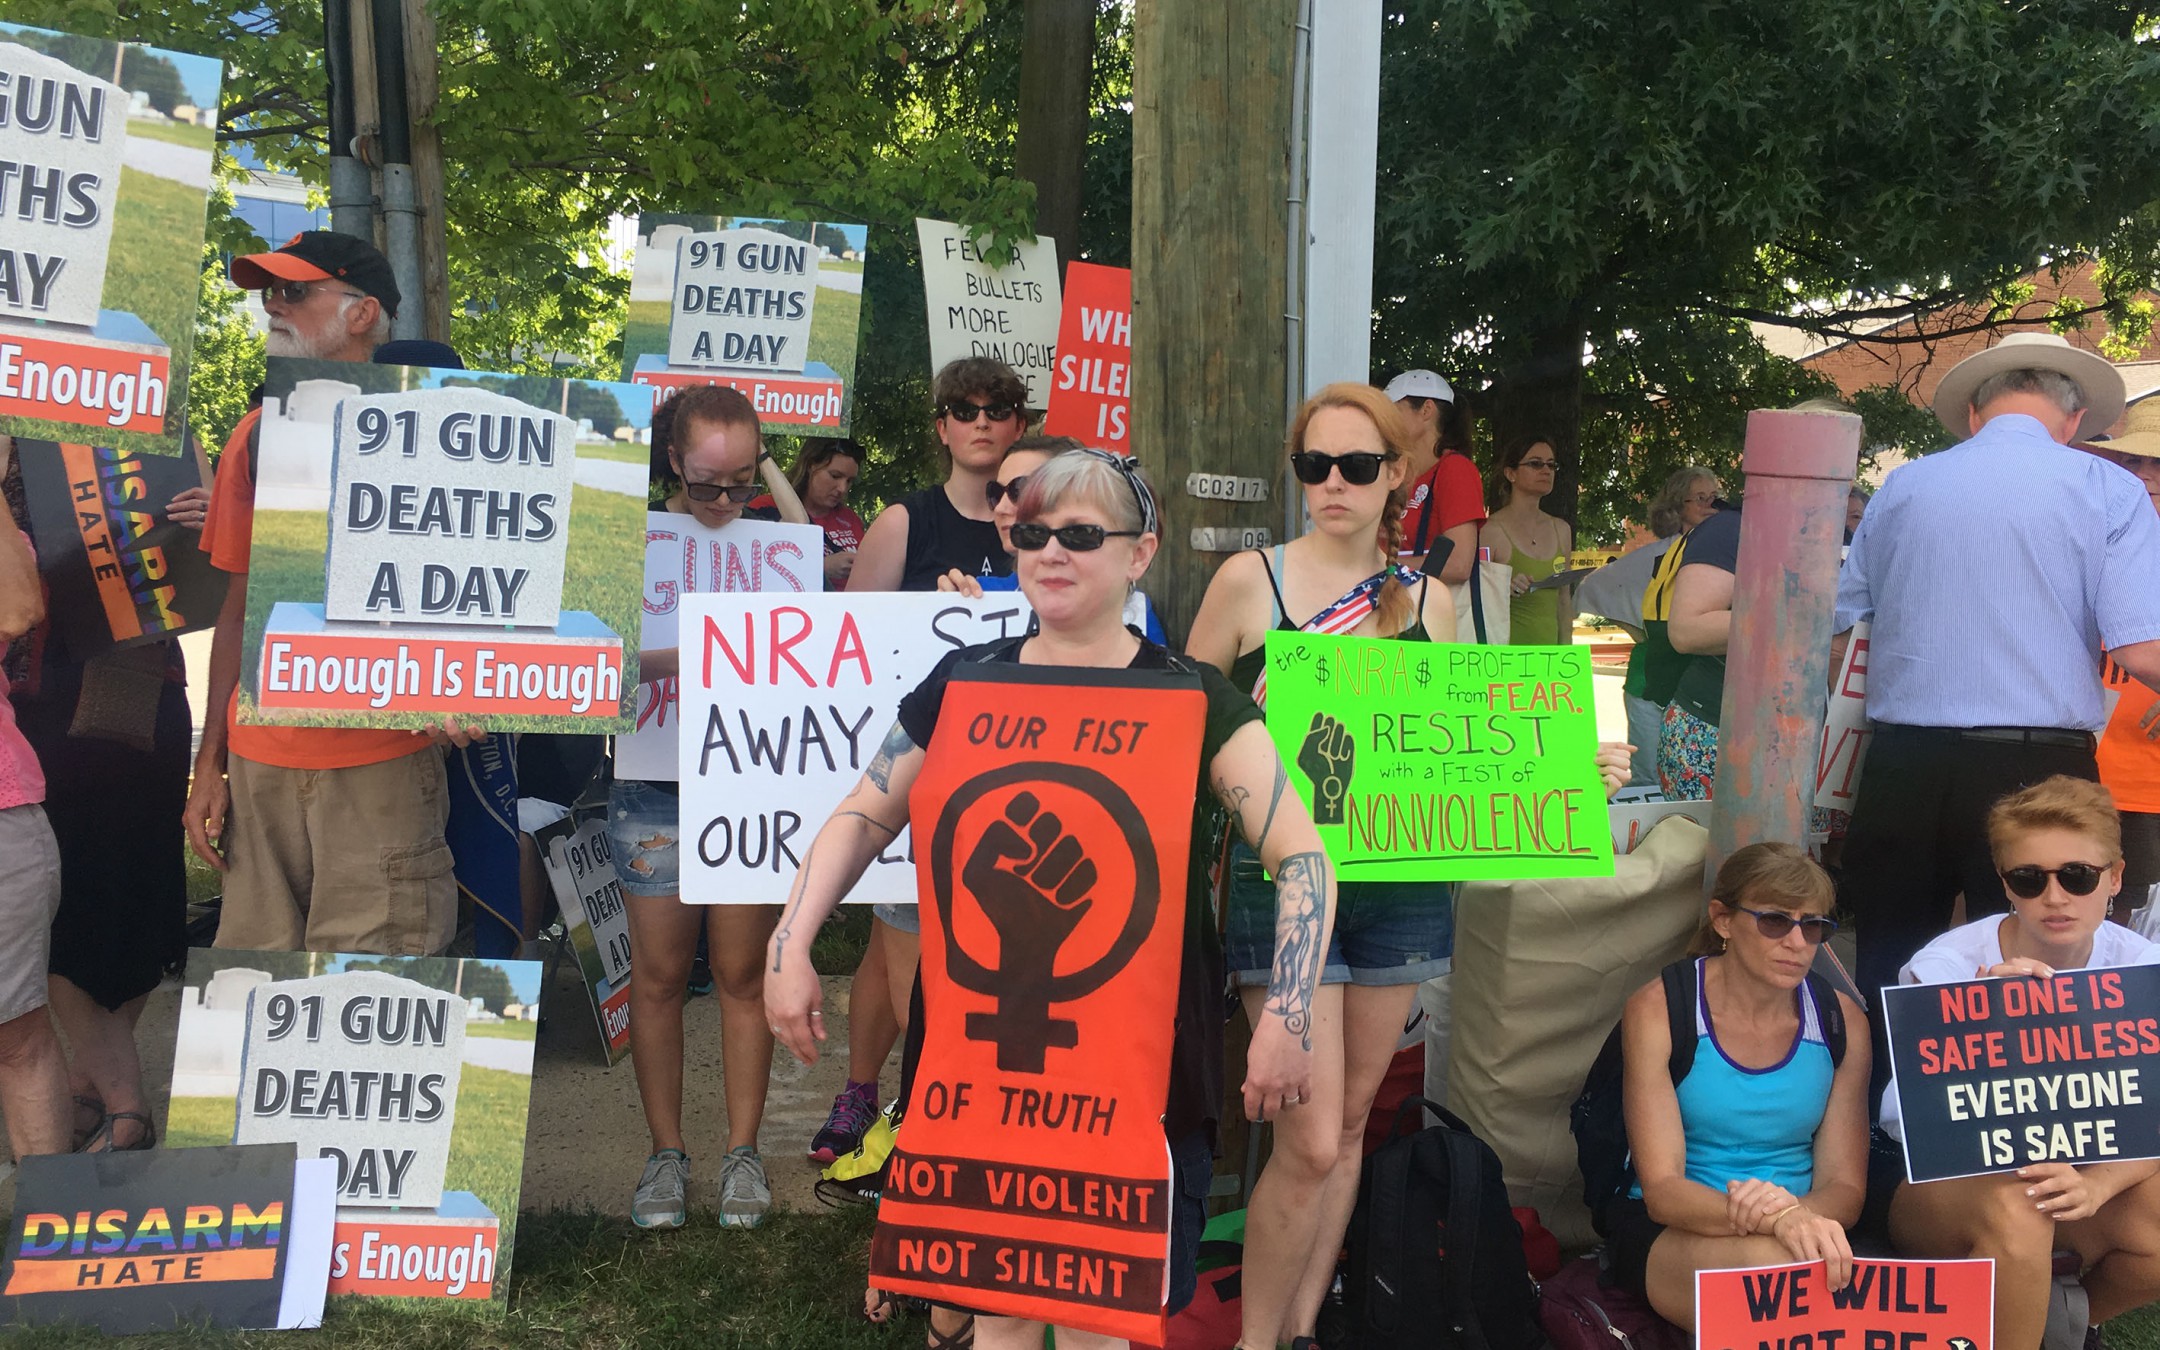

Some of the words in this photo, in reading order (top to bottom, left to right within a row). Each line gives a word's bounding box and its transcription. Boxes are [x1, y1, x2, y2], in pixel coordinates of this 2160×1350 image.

[0, 70, 103, 142] UN
[689, 240, 726, 271] 91
[737, 243, 808, 275] GUN
[944, 237, 1026, 271] FER
[682, 284, 807, 319] DEATHS
[966, 272, 1043, 303] BULLETS
[948, 306, 1013, 334] MORE
[691, 331, 714, 361] A
[723, 332, 788, 365] DAY
[972, 340, 1056, 371] DIALOGUE
[0, 343, 163, 427] Enough
[1058, 354, 1131, 398] SILE
[754, 383, 840, 424] Enough
[1096, 403, 1127, 441] IS
[356, 407, 419, 457] 91
[438, 411, 556, 467] GUN
[73, 479, 119, 581] HATE
[346, 481, 557, 542] DEATHS
[365, 561, 404, 613] A
[420, 563, 529, 617] DAY
[643, 529, 807, 615] GUNS
[268, 641, 421, 709] Enough
[431, 647, 464, 699] Is
[474, 649, 621, 714] Enough
[1275, 645, 1312, 672] the
[1449, 651, 1581, 679] PROFITS
[1446, 684, 1488, 704] from
[1488, 681, 1584, 714] FEAR.
[698, 703, 874, 777] AWAY
[968, 712, 1048, 751] OUR
[1073, 718, 1149, 755] FIST
[1373, 712, 1552, 757] RESIST
[1379, 762, 1414, 780] with
[1423, 766, 1435, 780] a
[1443, 762, 1504, 786] FIST
[1512, 761, 1537, 783] of
[697, 810, 803, 874] OUR
[1348, 788, 1592, 855] NONVIOLENCE
[570, 844, 593, 880] 91
[591, 830, 612, 867] GU
[585, 879, 625, 929] DEAT
[266, 993, 324, 1040] 91
[340, 994, 449, 1046] GUN
[1940, 985, 1990, 1024] NO
[2002, 976, 2078, 1018] ONE
[2088, 972, 2125, 1010] IS
[1918, 1031, 2008, 1075] SAFE
[2018, 1018, 2160, 1065] UNLESS
[252, 1067, 446, 1122] DEATHS
[923, 1081, 973, 1121] OF
[999, 1085, 1117, 1137] TRUTH
[1946, 1068, 2143, 1122] EVERYONE
[1980, 1128, 2015, 1167] IS
[2025, 1119, 2119, 1161] SAFE
[888, 1155, 960, 1199] NOT
[985, 1168, 1155, 1224] VIOLENT
[18, 1201, 285, 1258] DISARM
[76, 1256, 204, 1287] HATE
[357, 1230, 495, 1297] Enough
[898, 1238, 977, 1278] NOT
[995, 1248, 1129, 1299] SILENT
[1742, 1268, 1812, 1323] WE
[1831, 1264, 1948, 1314] WILL
